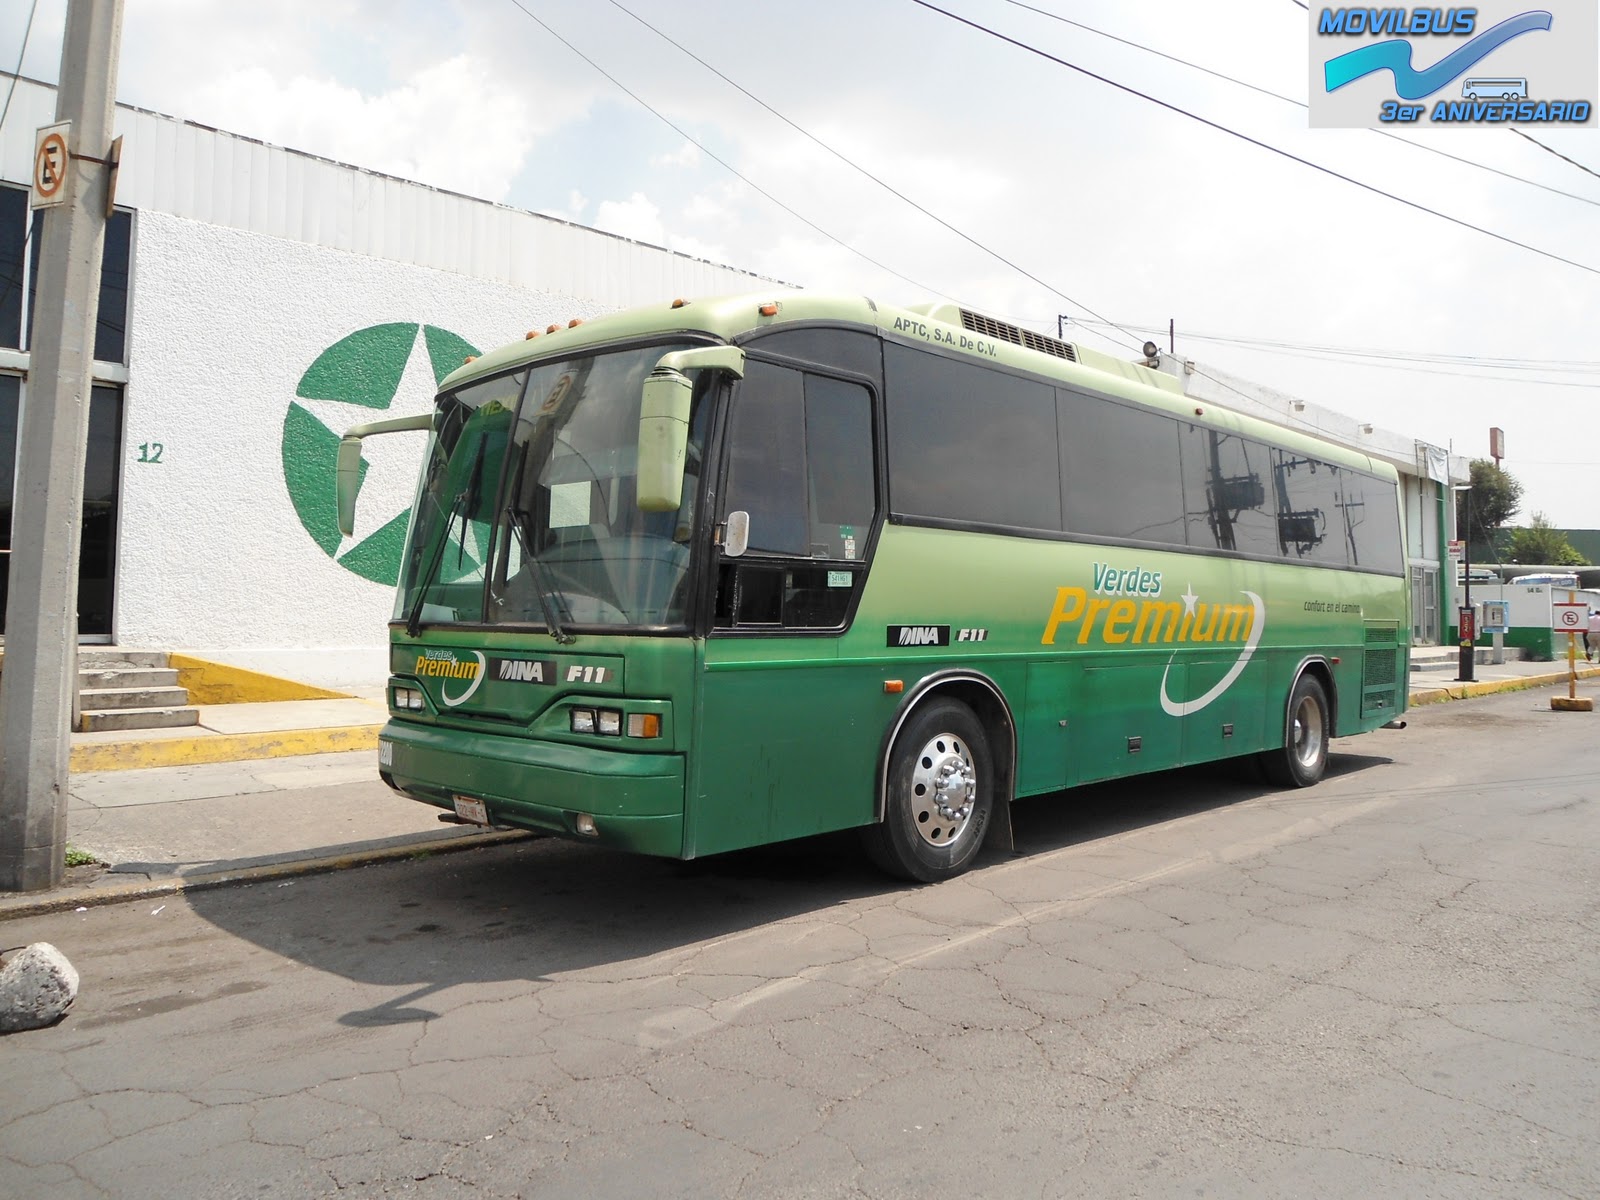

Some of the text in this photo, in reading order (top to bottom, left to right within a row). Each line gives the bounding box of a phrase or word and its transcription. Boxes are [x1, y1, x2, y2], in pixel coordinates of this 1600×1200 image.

[893, 316, 997, 357] APTC, S.A. De C.V.
[137, 442, 163, 464] 12
[1093, 562, 1162, 598] Verdes
[1041, 586, 1256, 645] Premium
[898, 626, 985, 646] DINA F11
[425, 648, 453, 660] Verdes
[414, 655, 480, 680] Premium
[499, 659, 606, 684] DINA F11
